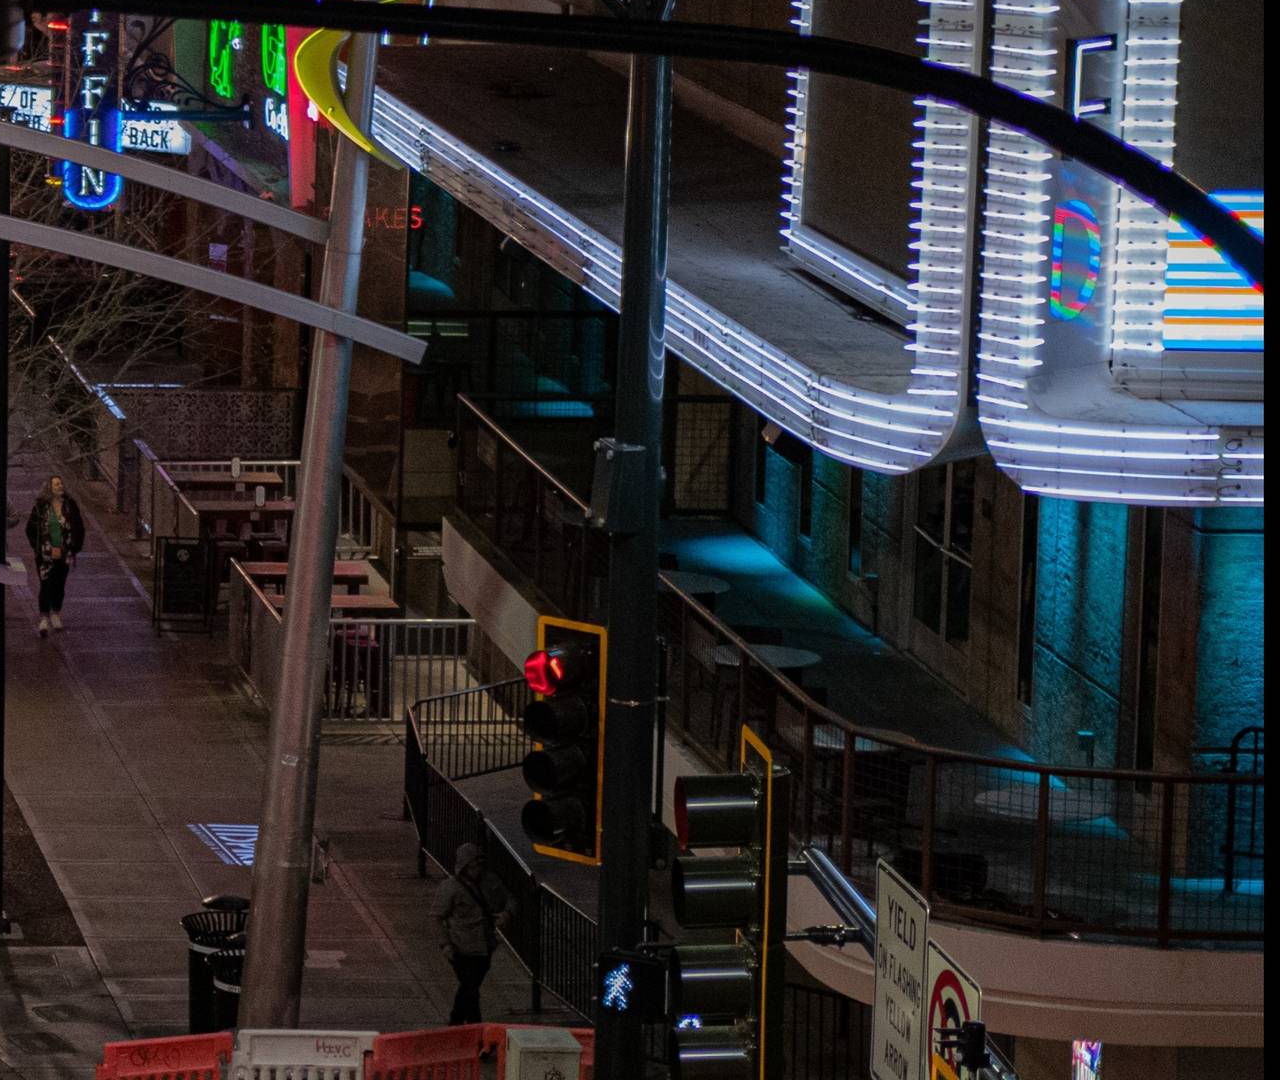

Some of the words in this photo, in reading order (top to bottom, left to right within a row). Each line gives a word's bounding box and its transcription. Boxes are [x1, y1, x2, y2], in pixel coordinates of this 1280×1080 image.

[20, 90, 38, 109] OF
[129, 127, 169, 150] BACK
[888, 896, 917, 951] YIELD
[885, 991, 912, 1045] YELLOW
